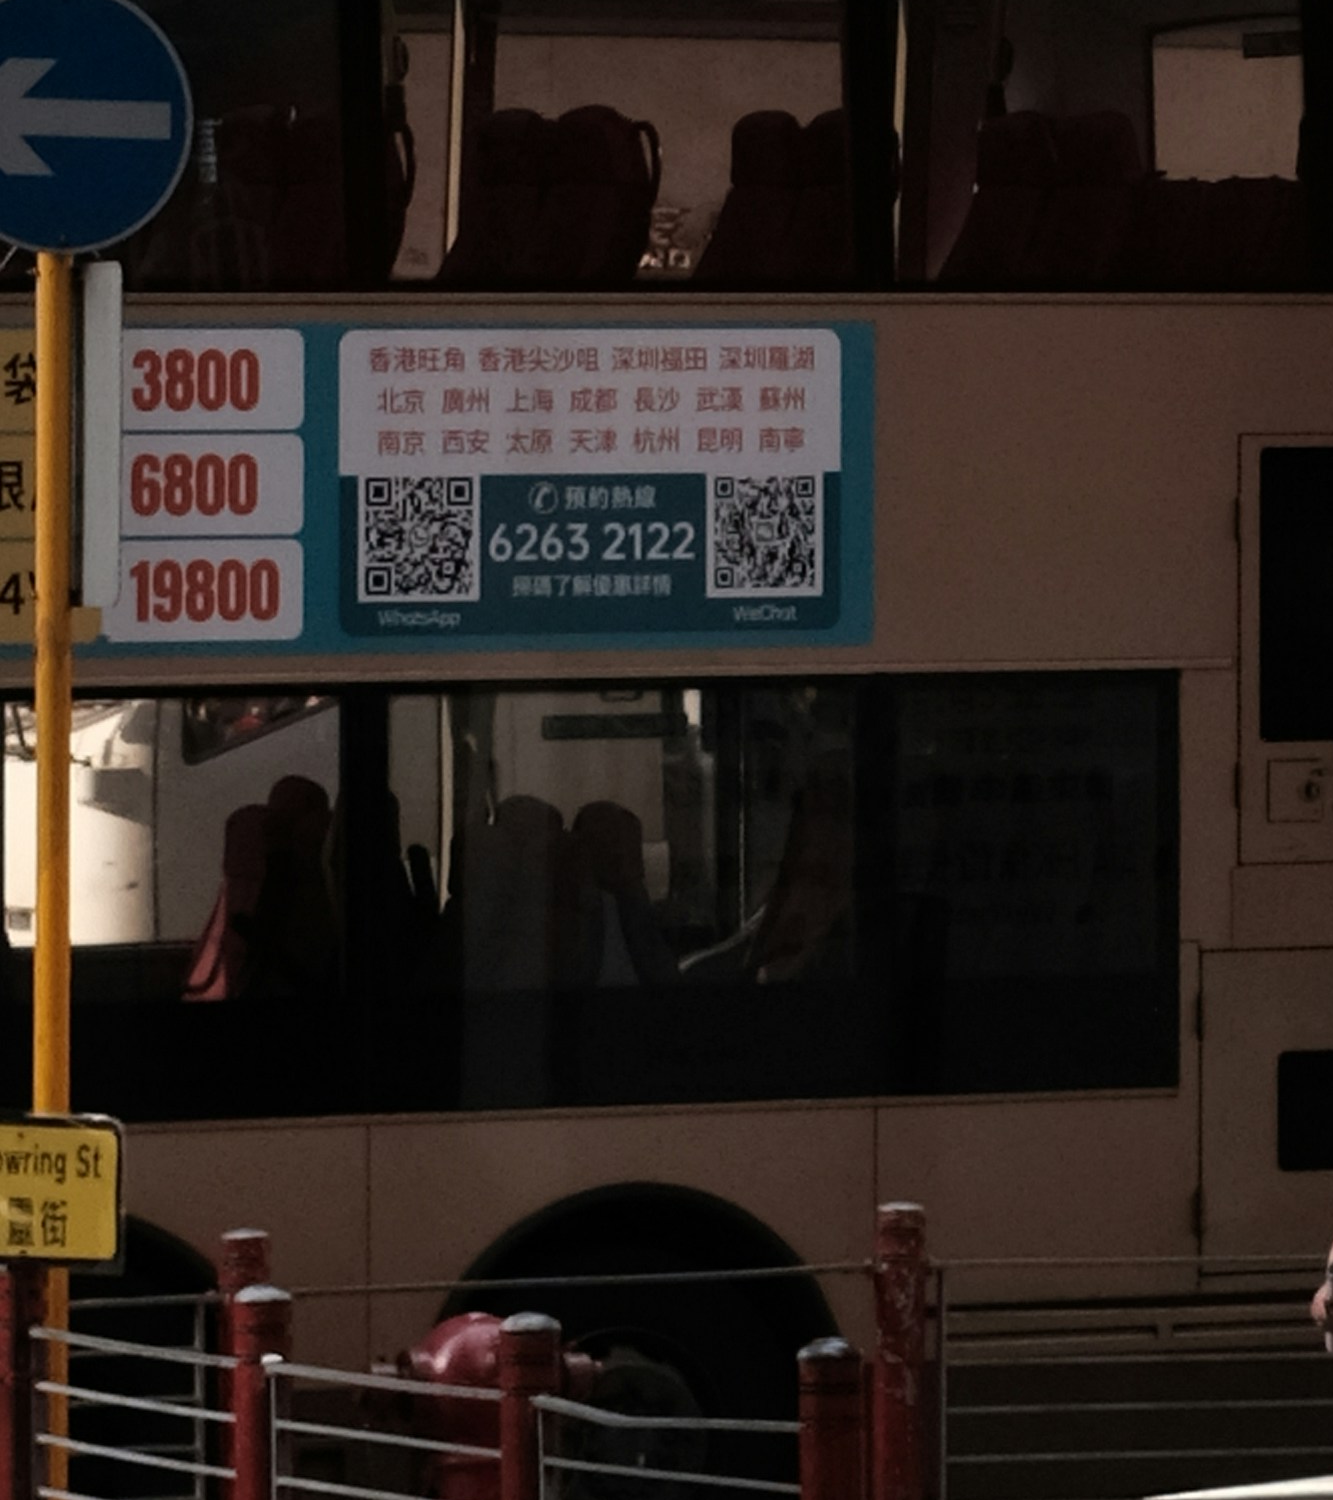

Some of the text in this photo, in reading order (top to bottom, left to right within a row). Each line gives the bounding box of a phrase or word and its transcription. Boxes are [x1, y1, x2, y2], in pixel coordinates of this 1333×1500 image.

[131, 348, 260, 412] 3800
[377, 387, 425, 414] 北京
[506, 387, 554, 414] 上海
[377, 428, 425, 455] 南京
[442, 428, 489, 455] 西安
[130, 452, 258, 517] 6800
[488, 520, 697, 562] 6263 2122
[130, 558, 280, 623] 19800
[376, 608, 463, 628] WhatsApp
[732, 604, 799, 622] WeChat
[76, 1144, 102, 1179] St
